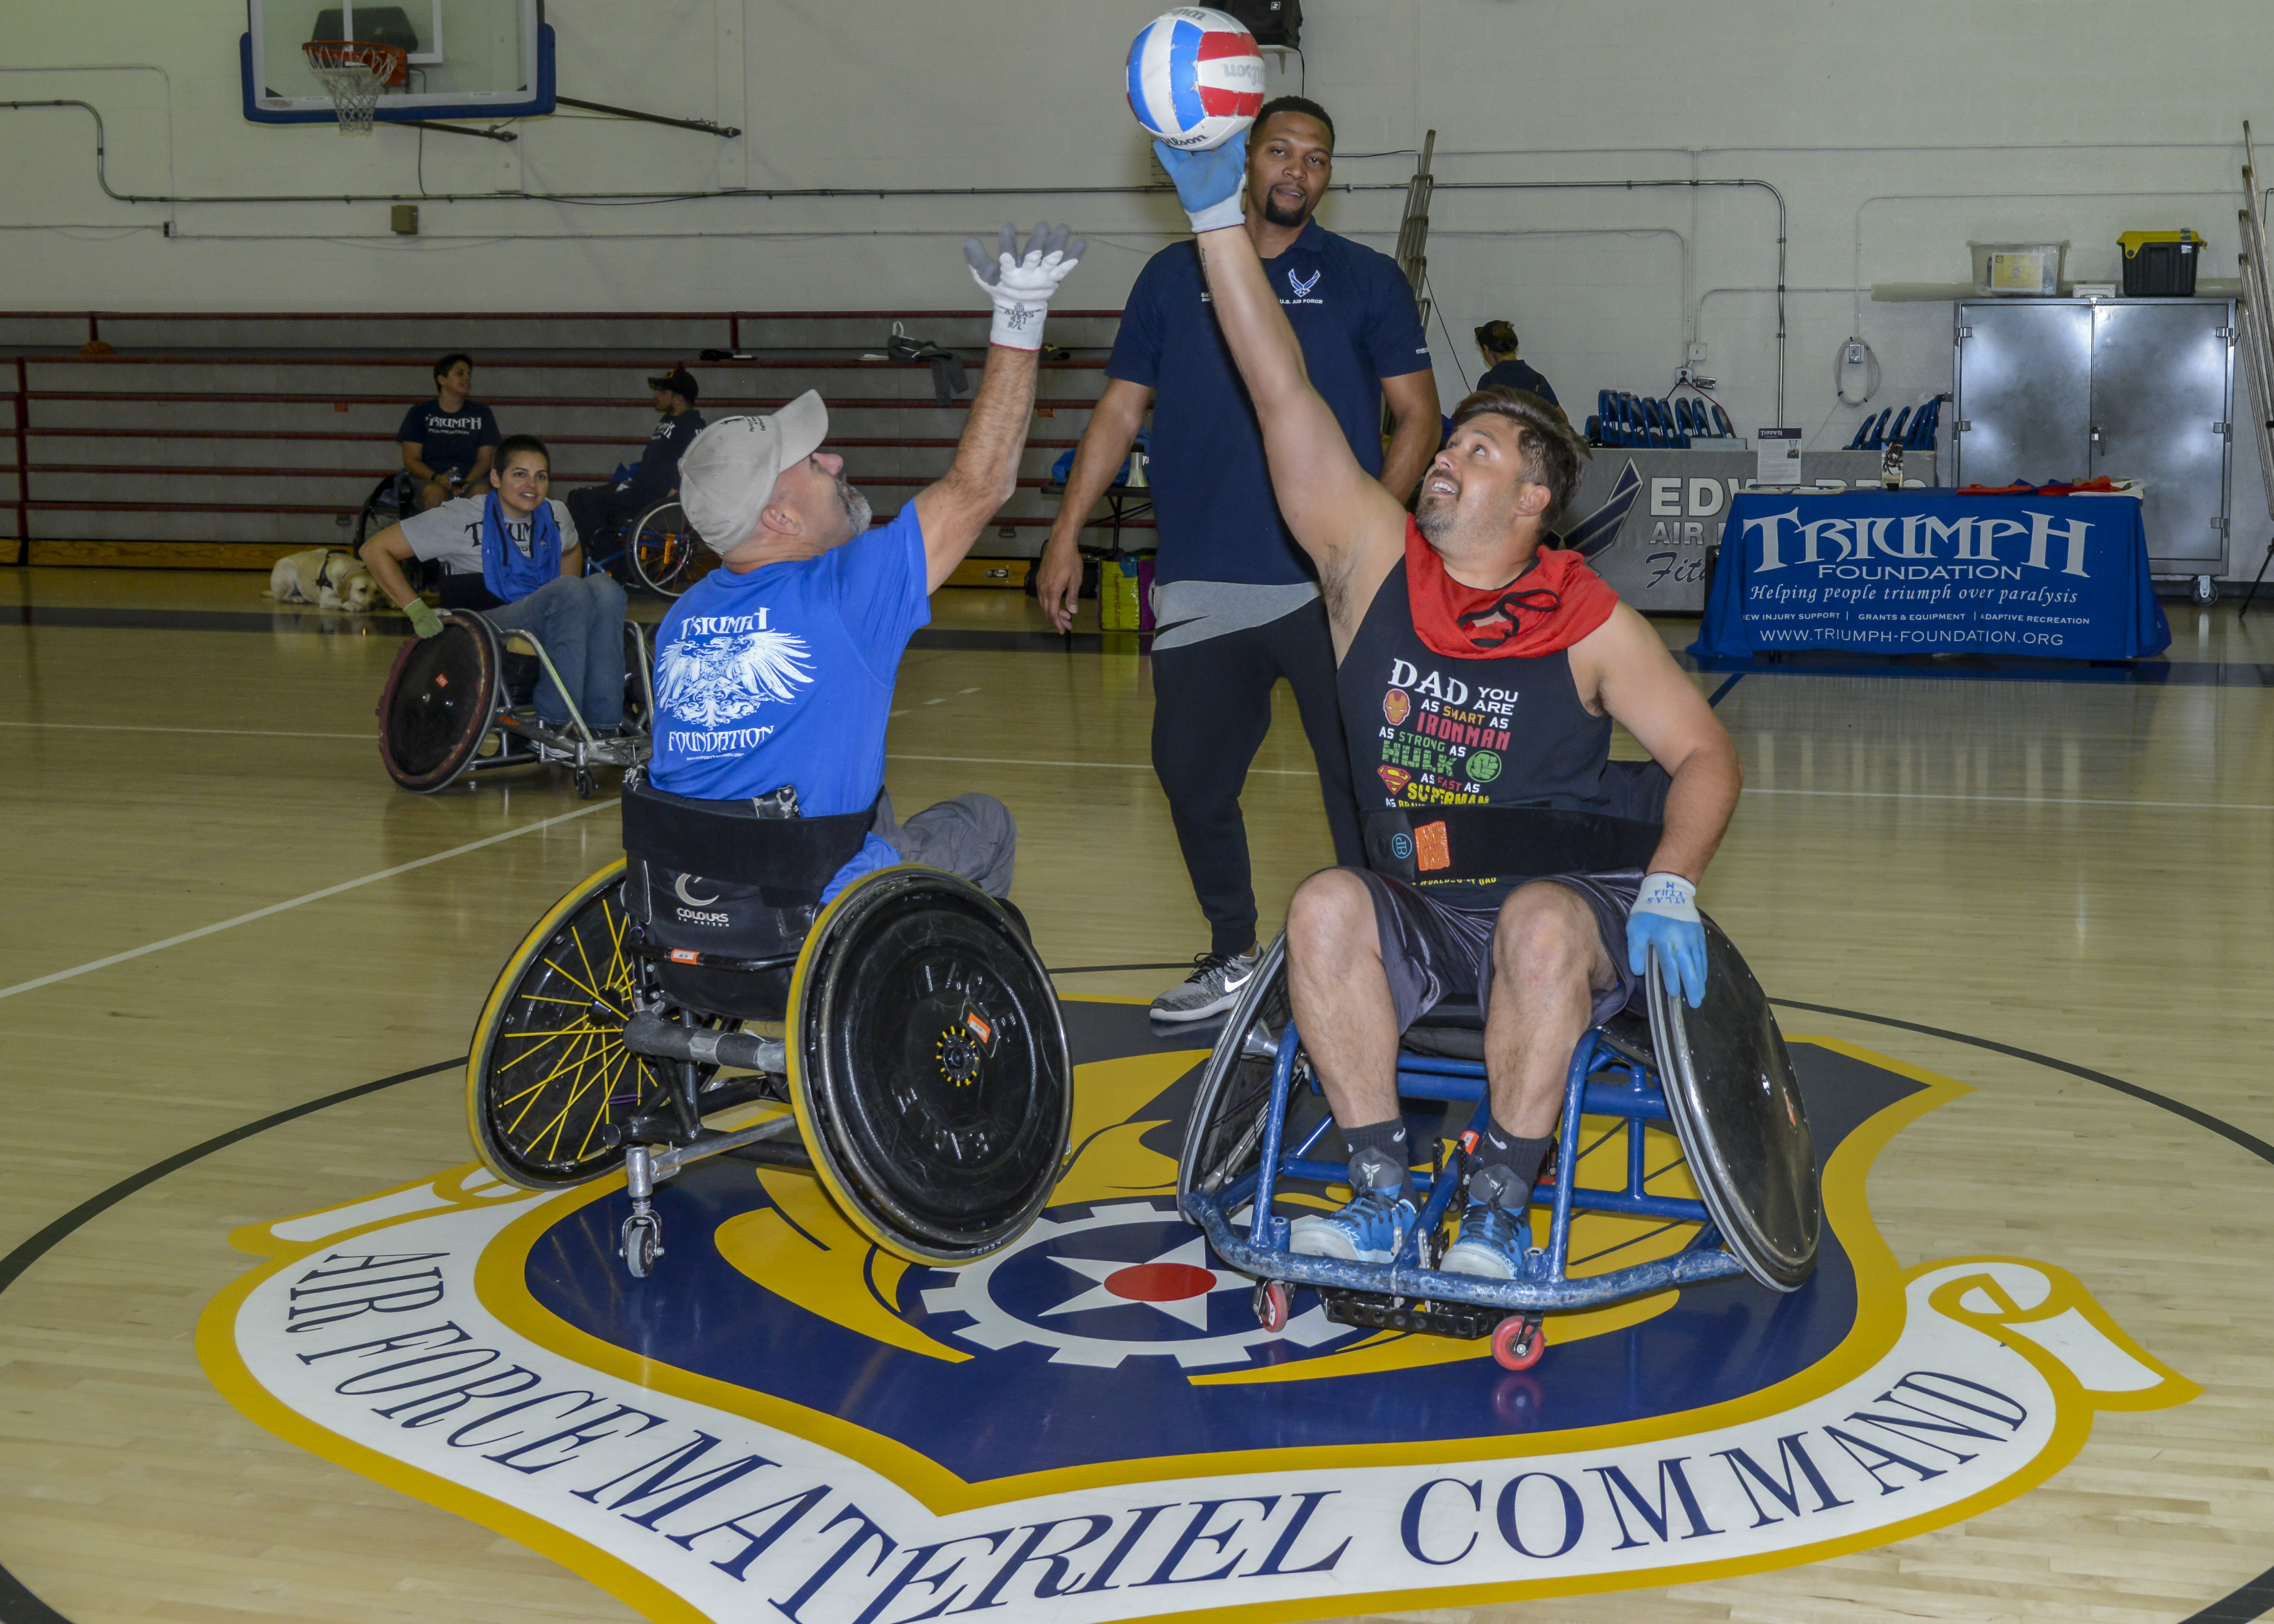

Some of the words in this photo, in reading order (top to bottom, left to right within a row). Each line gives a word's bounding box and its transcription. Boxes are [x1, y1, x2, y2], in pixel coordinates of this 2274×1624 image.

[1010, 315, 1027, 324] 451
[1649, 521, 1704, 545] AIR
[1742, 506, 2096, 578] TRIUMPH
[1818, 564, 2022, 580] FOUNDATION
[1750, 584, 1817, 604] Helping
[1823, 584, 1876, 604] people
[1884, 584, 1951, 604] triumph
[1959, 587, 1994, 599] over
[1998, 587, 2078, 607] paralysis
[2027, 615, 2090, 624] RECREATION
[1760, 628, 2064, 645] WWW.TRIUMPH-FOUNDATION.ORG
[1387, 658, 1468, 705] DAD
[1478, 686, 1519, 703] YOU
[1420, 698, 1440, 713] AS
[1442, 705, 1485, 725] SMART
[1489, 716, 1509, 729] AS
[1472, 700, 1515, 716] ARE
[668, 725, 775, 753] FOUNDATION
[1379, 726, 1395, 740] AS
[1399, 731, 1446, 753] STRONG
[1449, 745, 1467, 758] AS
[1417, 711, 1511, 751] IRONMAN
[1382, 740, 1457, 777] HULK
[1420, 773, 1435, 785] AS
[1437, 776, 1462, 792] FAST
[1463, 782, 1480, 793] AS
[1385, 797, 1397, 808] AS
[676, 907, 729, 922] COLOURS
[285, 1251, 451, 1334] AIR
[295, 1320, 670, 1475] FORCE
[1400, 1371, 2028, 1566] COMMAND
[569, 1430, 1353, 1624] MATERIEL
